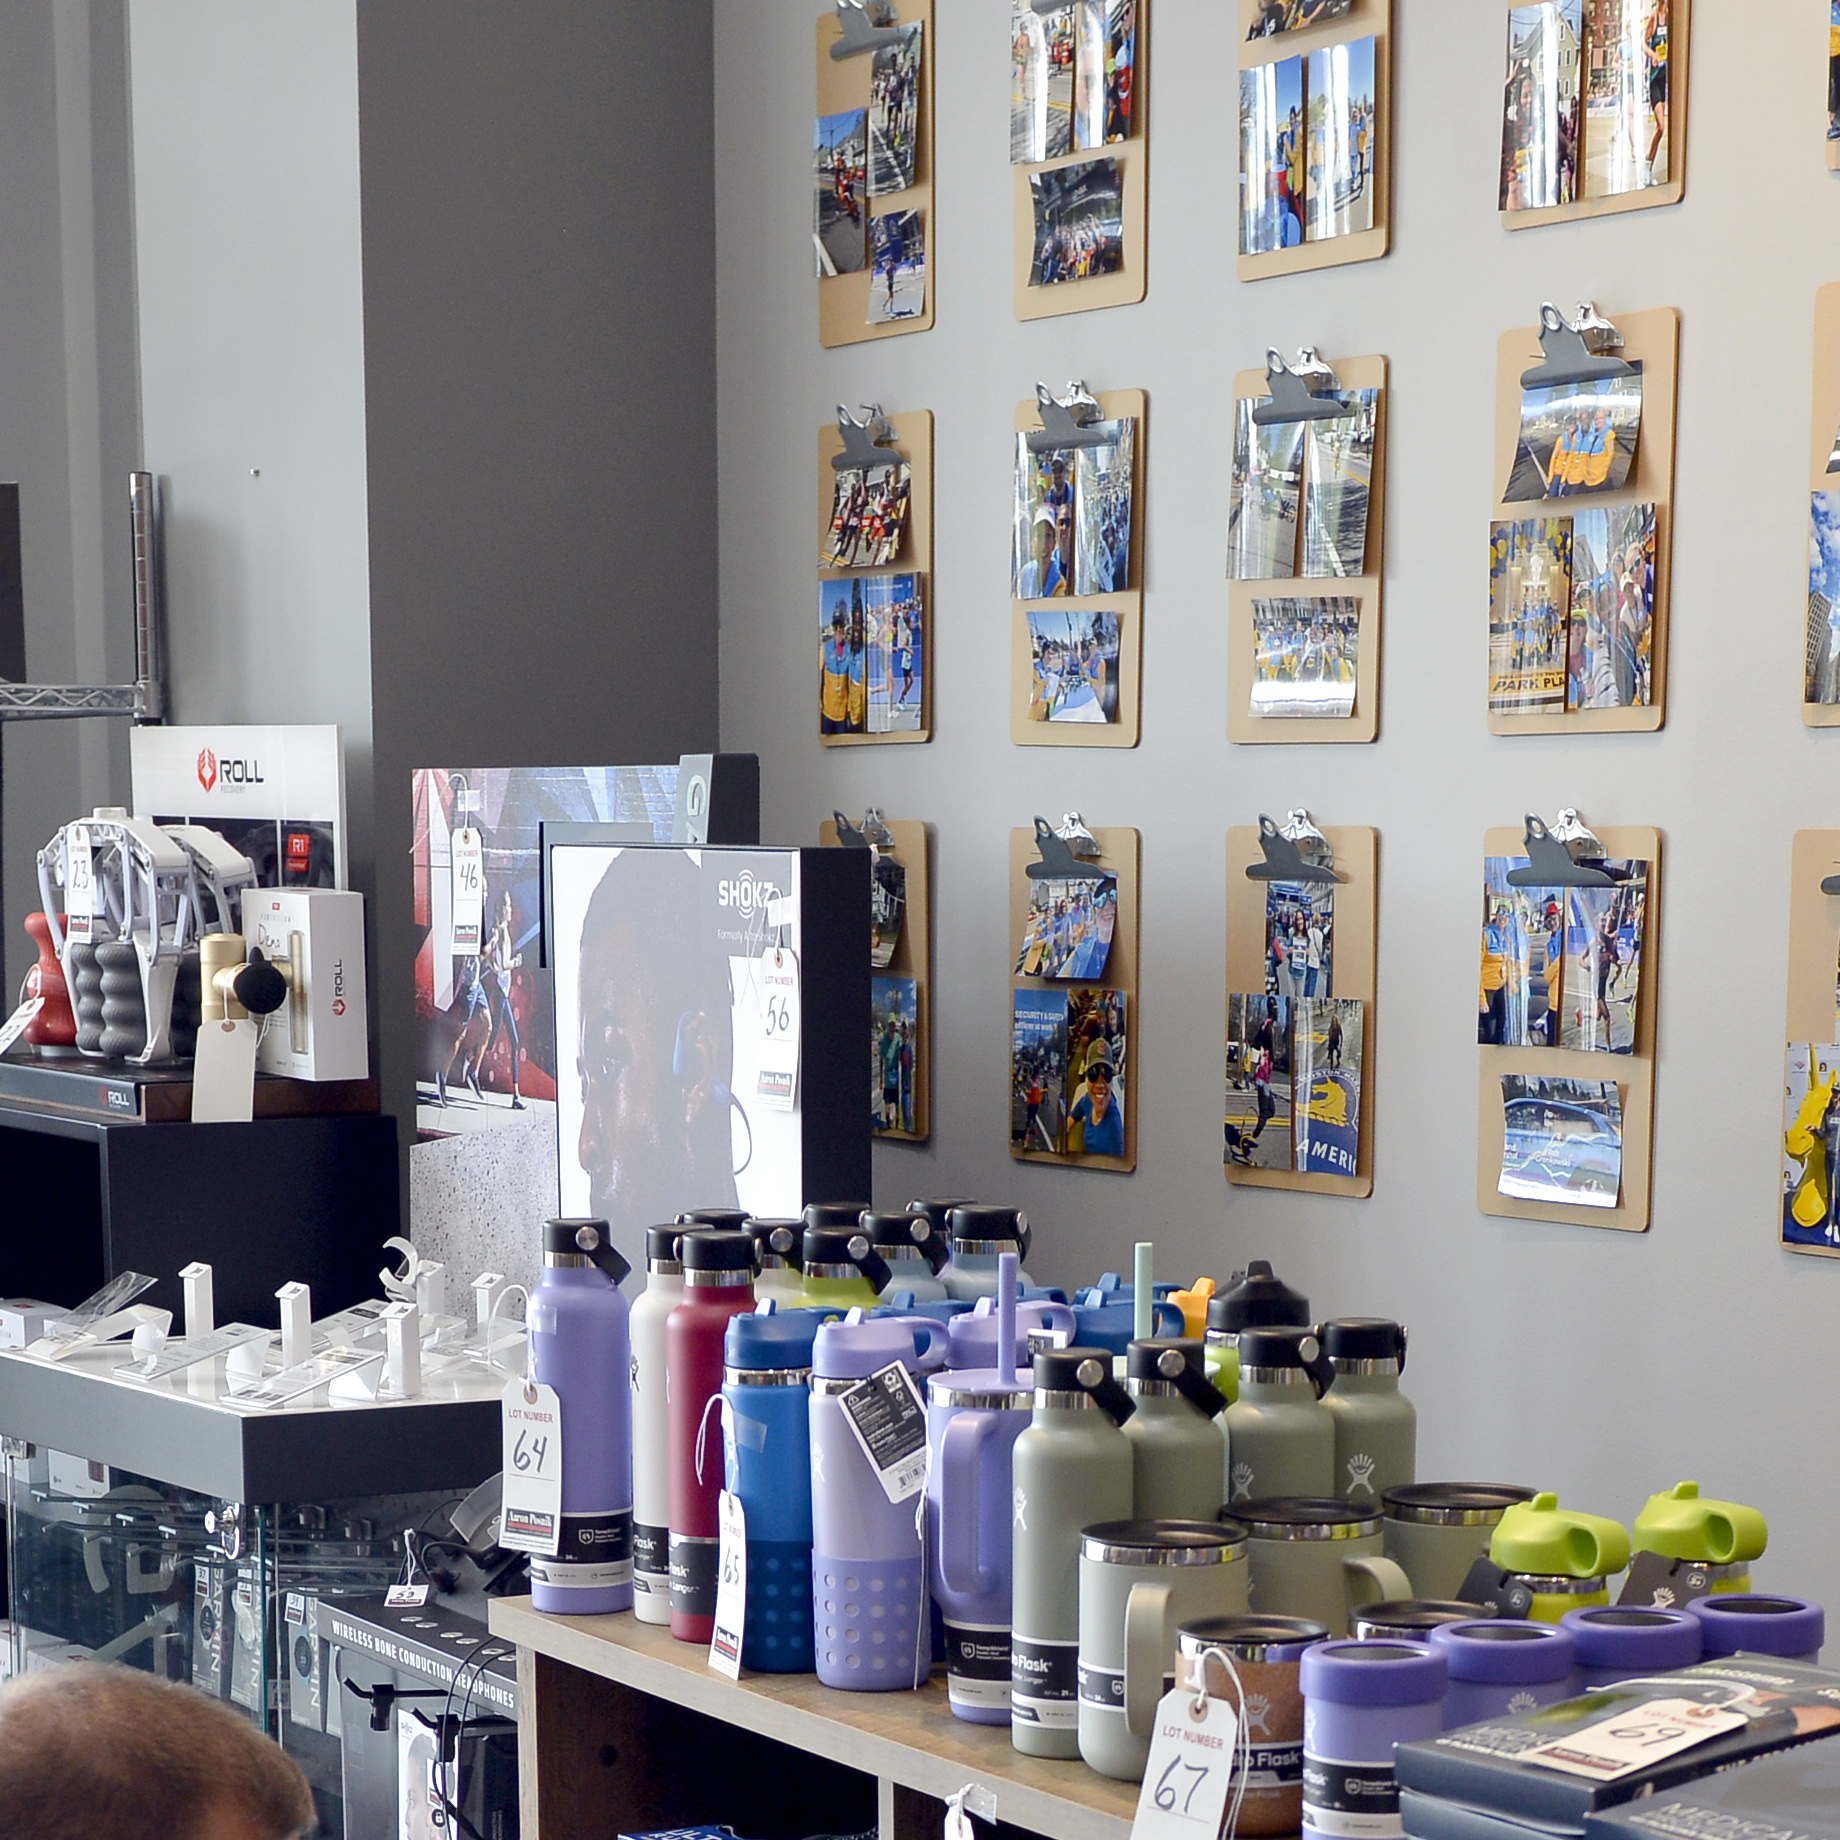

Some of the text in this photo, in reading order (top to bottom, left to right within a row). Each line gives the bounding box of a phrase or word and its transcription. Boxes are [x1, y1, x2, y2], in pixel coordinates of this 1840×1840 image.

[220, 758, 265, 785] ROLL
[459, 862, 478, 892] 46
[333, 957, 345, 998] ROLL
[765, 995, 791, 1036] 56
[108, 1090, 131, 1107] ROLL
[508, 1408, 554, 1424] LOT NUMBER
[513, 1428, 547, 1474] 64
[508, 1510, 553, 1528] Aaron Posnik
[724, 1546, 740, 1586] 65
[210, 1567, 225, 1674] GARMIN
[331, 1619, 515, 1709] WIRELESS BONE CONDUCTION HEADPHONES
[1163, 1724, 1224, 1751] LOT NUMBER
[1607, 1723, 1688, 1747] 69
[1153, 1753, 1210, 1815] 67
